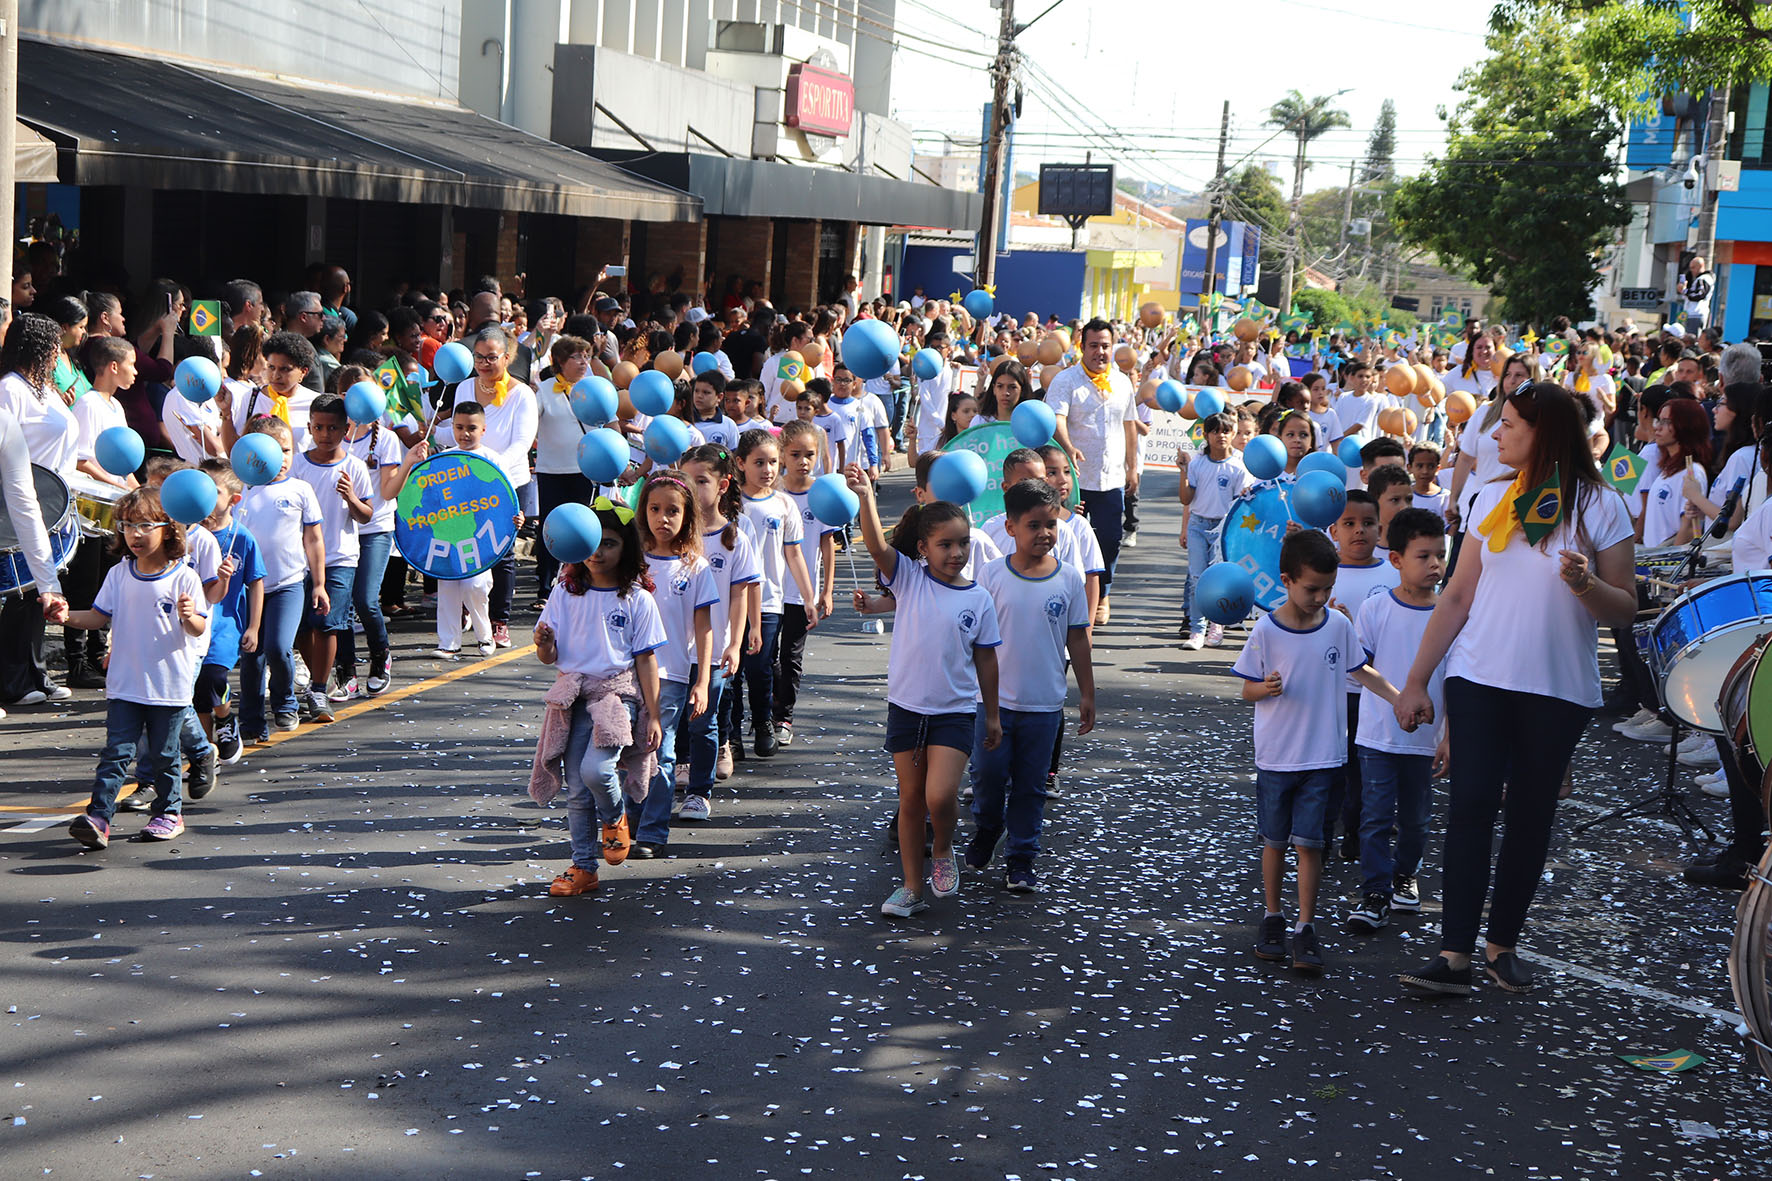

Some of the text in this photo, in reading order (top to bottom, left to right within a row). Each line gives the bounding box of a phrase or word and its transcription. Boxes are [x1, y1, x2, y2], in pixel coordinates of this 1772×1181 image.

[1623, 290, 1656, 300] BETO
[417, 464, 471, 488] ORDEM
[442, 487, 453, 501] E
[407, 495, 500, 530] PROGRESSO
[424, 518, 511, 573] PAZ
[1237, 554, 1289, 609] PAZ
